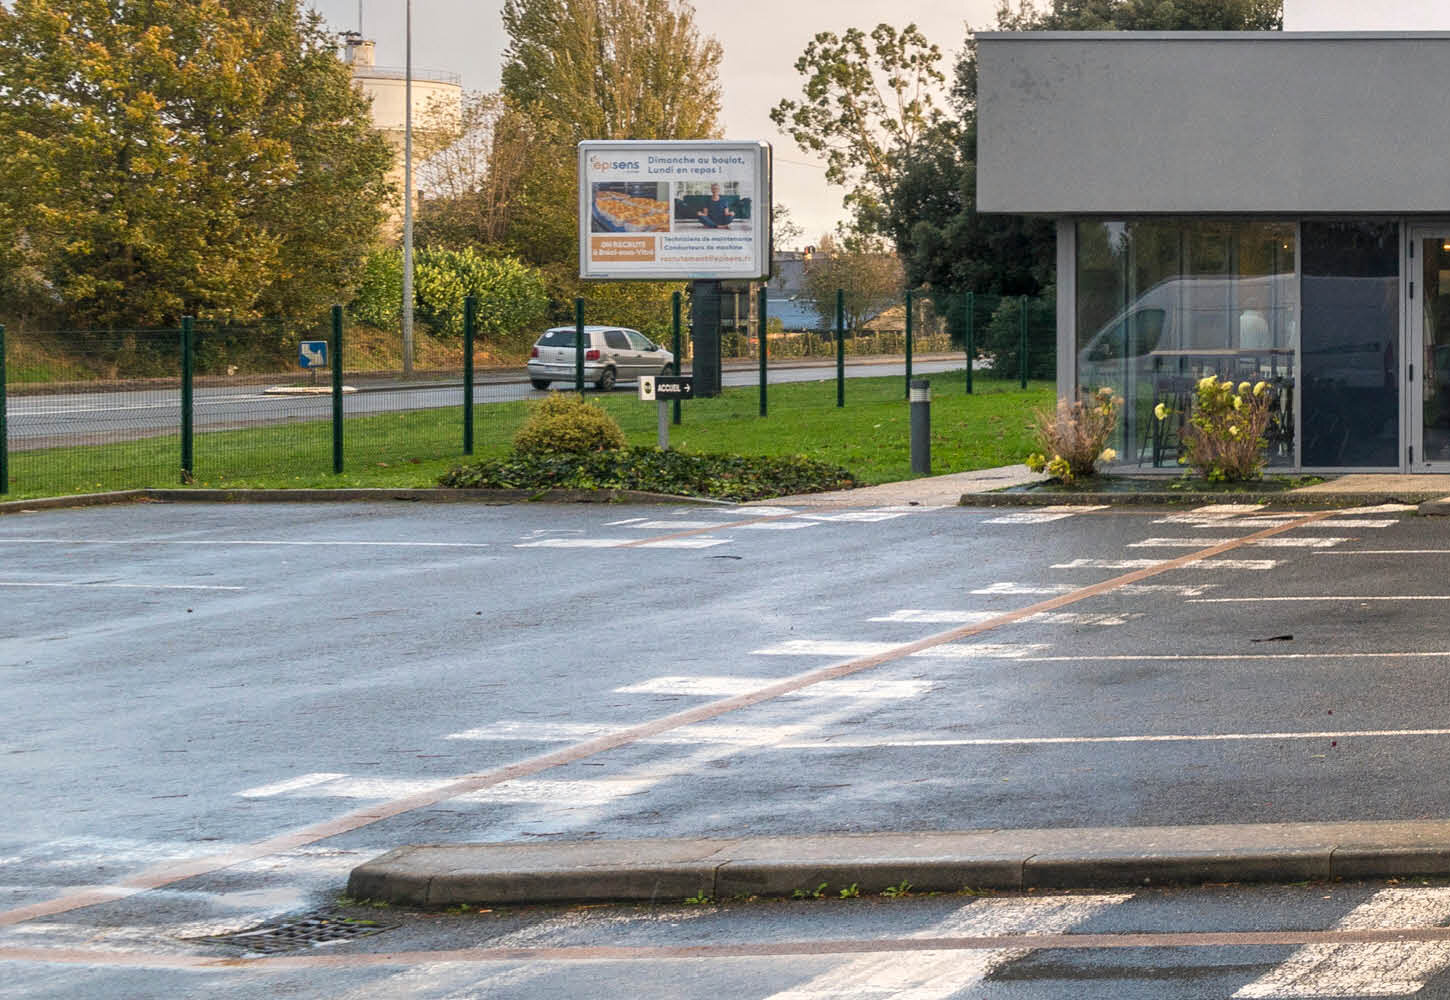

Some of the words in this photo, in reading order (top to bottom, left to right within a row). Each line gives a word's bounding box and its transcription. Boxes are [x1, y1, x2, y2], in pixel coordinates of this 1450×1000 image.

[648, 155, 695, 164] Dimanche
[712, 155, 745, 165] boulot,
[648, 166, 674, 174] Lundi
[690, 167, 717, 176] repos
[657, 383, 681, 392] ACCUEIL
